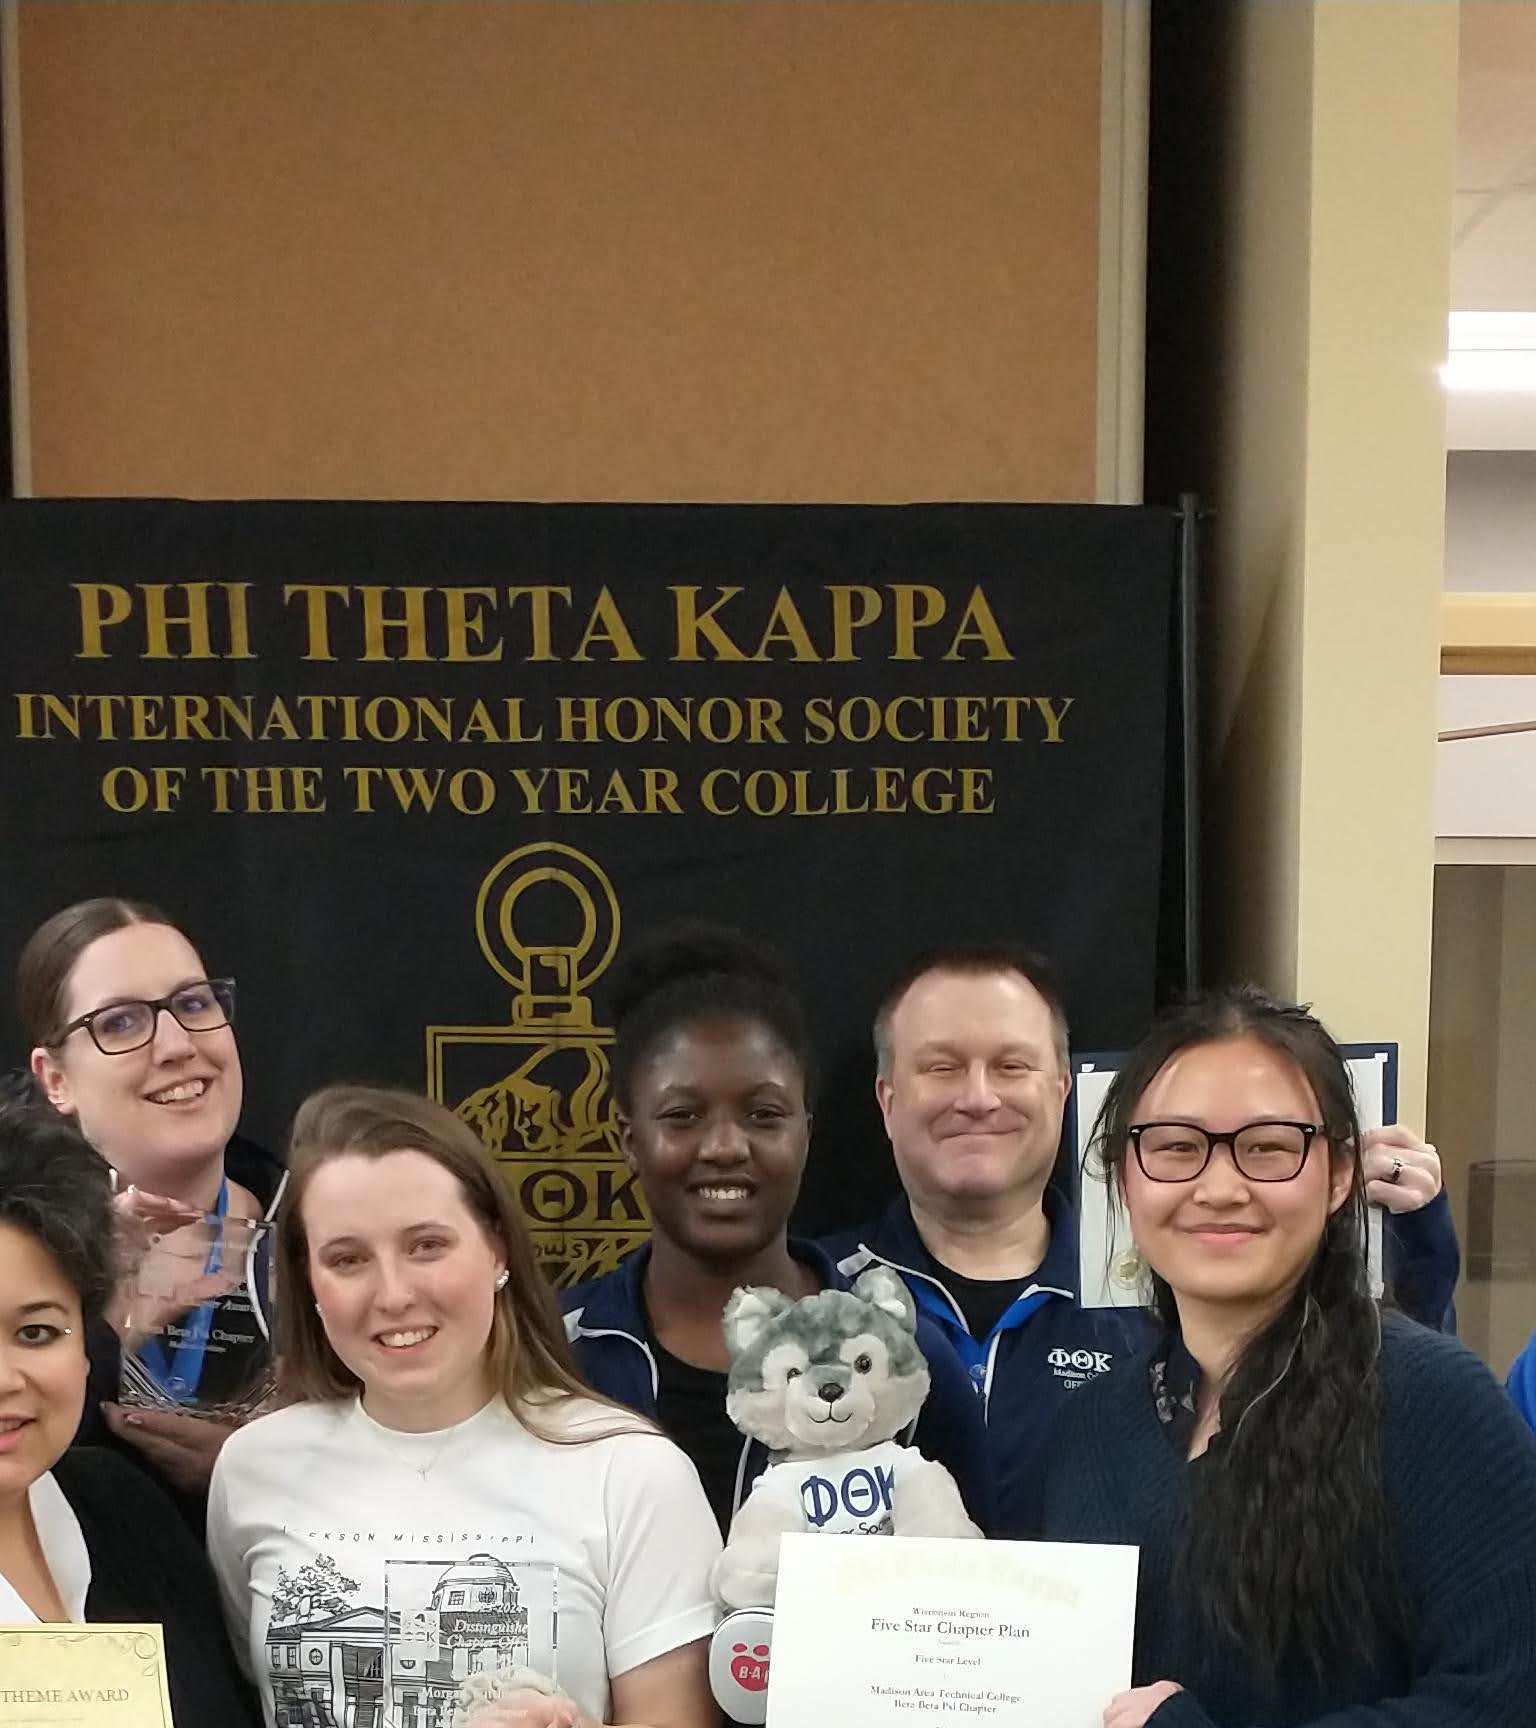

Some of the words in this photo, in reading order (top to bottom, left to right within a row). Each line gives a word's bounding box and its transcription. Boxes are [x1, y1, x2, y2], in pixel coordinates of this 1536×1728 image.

[73, 581, 255, 661] PHI
[285, 583, 643, 663] THETA
[669, 582, 1014, 663] KAPPA
[16, 692, 543, 744] INTERNATIONAL
[558, 696, 786, 744] HONOR
[803, 695, 1075, 744] SOCIETY
[101, 766, 189, 814] OF
[201, 766, 326, 814] THE
[343, 766, 498, 815] TWO
[510, 767, 681, 815] YEAR
[699, 767, 996, 816] COLLEGE
[520, 1168, 646, 1223] ΘΚ
[453, 1619, 529, 1635] Distinguishe
[871, 1618, 901, 1631] Five
[904, 1619, 934, 1633] Star
[937, 1621, 995, 1639] Chapter
[998, 1624, 1031, 1638] Plan
[915, 1654, 935, 1664] Five
[957, 1656, 982, 1667] Level
[2, 1689, 61, 1703] THEME
[68, 1688, 131, 1702] AWARD
[870, 1685, 912, 1697] Madison
[913, 1687, 936, 1698] Area
[939, 1689, 985, 1701] Technical
[986, 1691, 1023, 1704] College
[918, 1700, 940, 1710] Beta
[959, 1702, 998, 1715] Chapter
